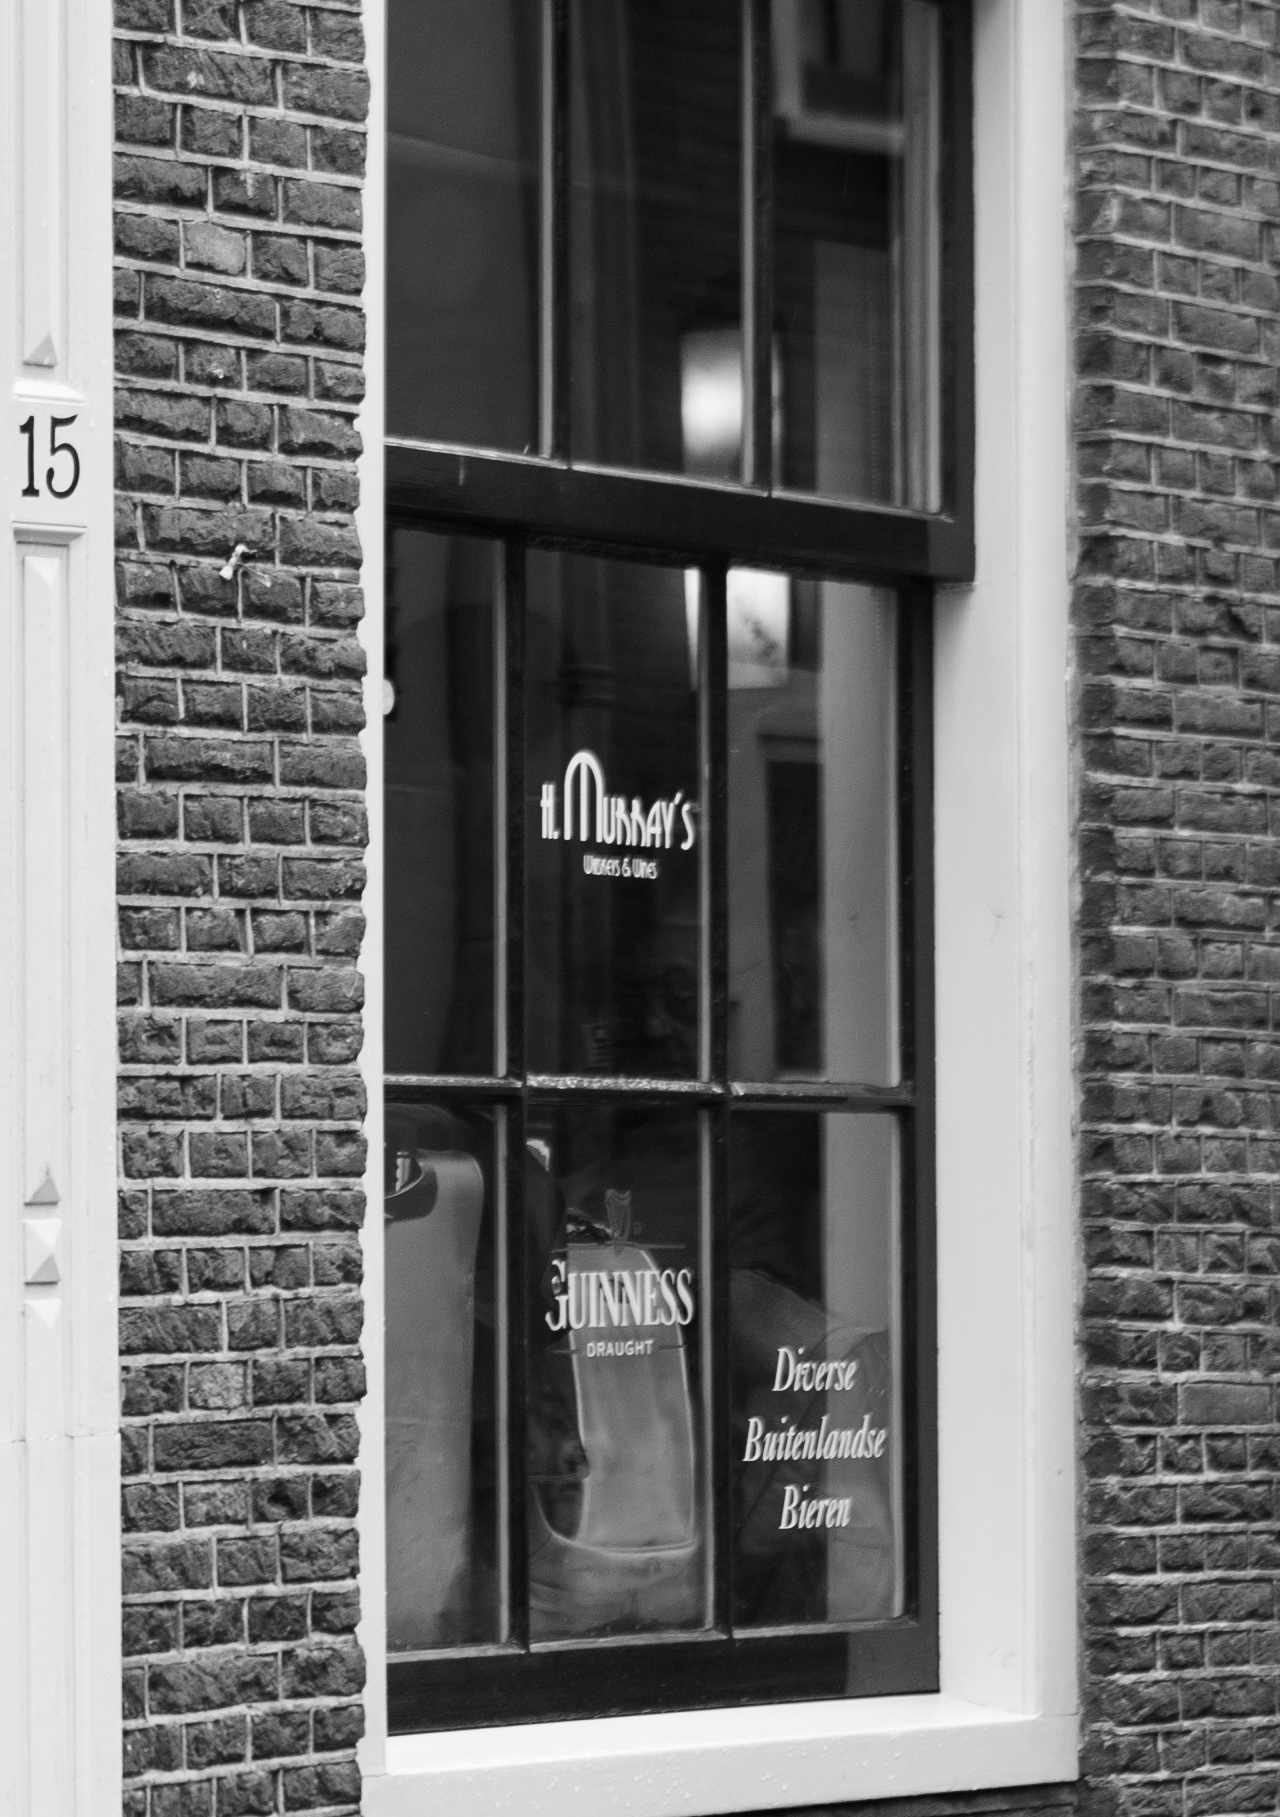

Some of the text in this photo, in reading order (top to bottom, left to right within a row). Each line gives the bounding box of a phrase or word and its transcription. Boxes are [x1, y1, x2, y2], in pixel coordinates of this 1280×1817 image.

[18, 413, 81, 499] 15
[545, 1259, 694, 1331] GUINNESS
[586, 1338, 655, 1358] DRAUGHT
[771, 1346, 857, 1393] Diverse
[743, 1415, 888, 1463] Buitenlandse
[778, 1485, 851, 1530] Bieren
